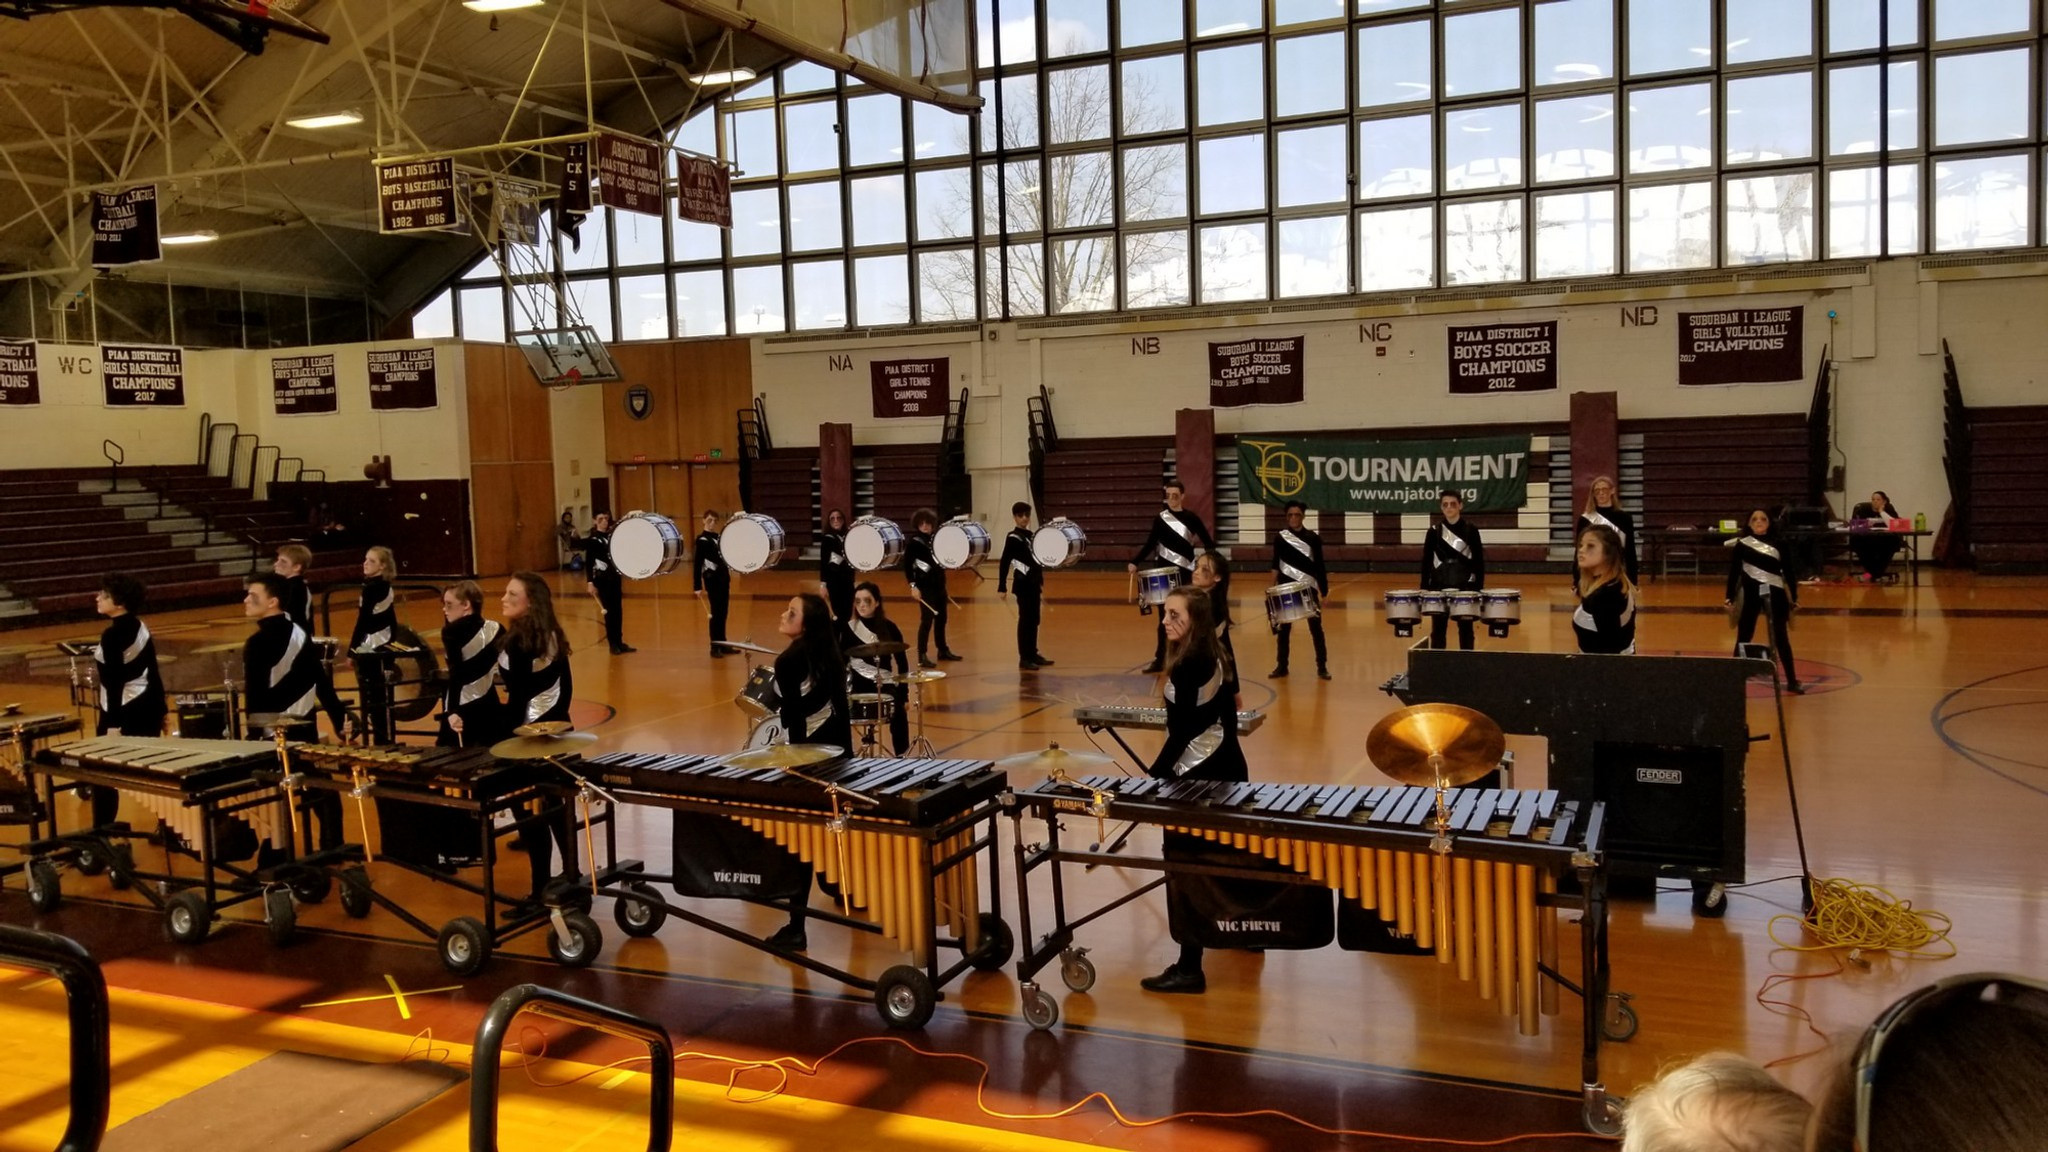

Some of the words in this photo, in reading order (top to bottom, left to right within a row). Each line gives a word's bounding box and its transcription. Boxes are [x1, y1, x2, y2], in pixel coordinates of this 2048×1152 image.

[384, 166, 402, 179] PIAA
[406, 162, 440, 176] DISTRICT
[382, 183, 401, 195] BOYS
[404, 179, 451, 193] BASKETBALL
[126, 188, 154, 203] LEAGUE
[392, 196, 442, 211] CHAMPIONS
[392, 217, 412, 228] 1982
[425, 213, 445, 225] 1986
[1621, 306, 1657, 327] ND
[1689, 313, 1739, 326] SUBURBAN
[1753, 310, 1791, 323] LEAGUE
[1360, 322, 1392, 343] NC
[1456, 331, 1483, 342] PIAA
[1487, 328, 1540, 340] DISTRICT
[1693, 327, 1721, 339] GIRLS
[1725, 324, 1788, 338] VOLLEYBALL
[1132, 337, 1160, 355] NB
[1217, 342, 1256, 356] SUBURBAN
[1265, 340, 1295, 352] LEAGUE
[1454, 345, 1492, 359] BOYS
[1495, 341, 1551, 357] SOCCER
[1694, 338, 1784, 352] CHAMPIONS
[108, 350, 129, 360] PIAA
[131, 350, 170, 361] DISTRICT
[311, 356, 333, 367] LEAGUE
[369, 352, 401, 362] SUBURBAN
[409, 350, 432, 360] LEAGUE
[1230, 355, 1250, 367] BOYS
[1252, 353, 1281, 364] SOCCER
[104, 362, 128, 374] GIRLS
[130, 363, 182, 376] BASKETBALL
[370, 363, 388, 372] GIRLS
[389, 361, 409, 371] TRACK
[415, 360, 432, 370] FIELD
[829, 354, 853, 372] NA
[885, 365, 899, 375] PIAA
[901, 364, 929, 374] DISTRICT
[1459, 359, 1546, 377] CHAMPIONS
[275, 370, 291, 378] BOYS
[291, 368, 310, 378] TRACK
[316, 366, 332, 376] FIELD
[385, 372, 419, 382] CHAMPIONS
[1221, 364, 1291, 379] CHAMPIONS
[112, 377, 176, 390] CHAMPIONS
[288, 377, 321, 388] CHAMPIONS
[890, 378, 907, 387] GIRLS
[909, 377, 931, 386] TENNIS
[1488, 378, 1516, 389] 2012
[134, 391, 156, 401] 2017
[894, 390, 927, 400] CHAMPIONS
[1308, 452, 1525, 482] TOURNAMENT
[1350, 487, 1478, 504] www.njatorg
[1140, 713, 1167, 723] Rola
[714, 872, 732, 882] VIC
[733, 872, 761, 884] FIRTH
[1216, 920, 1239, 932] VIC
[1242, 920, 1281, 932] FIRTH
